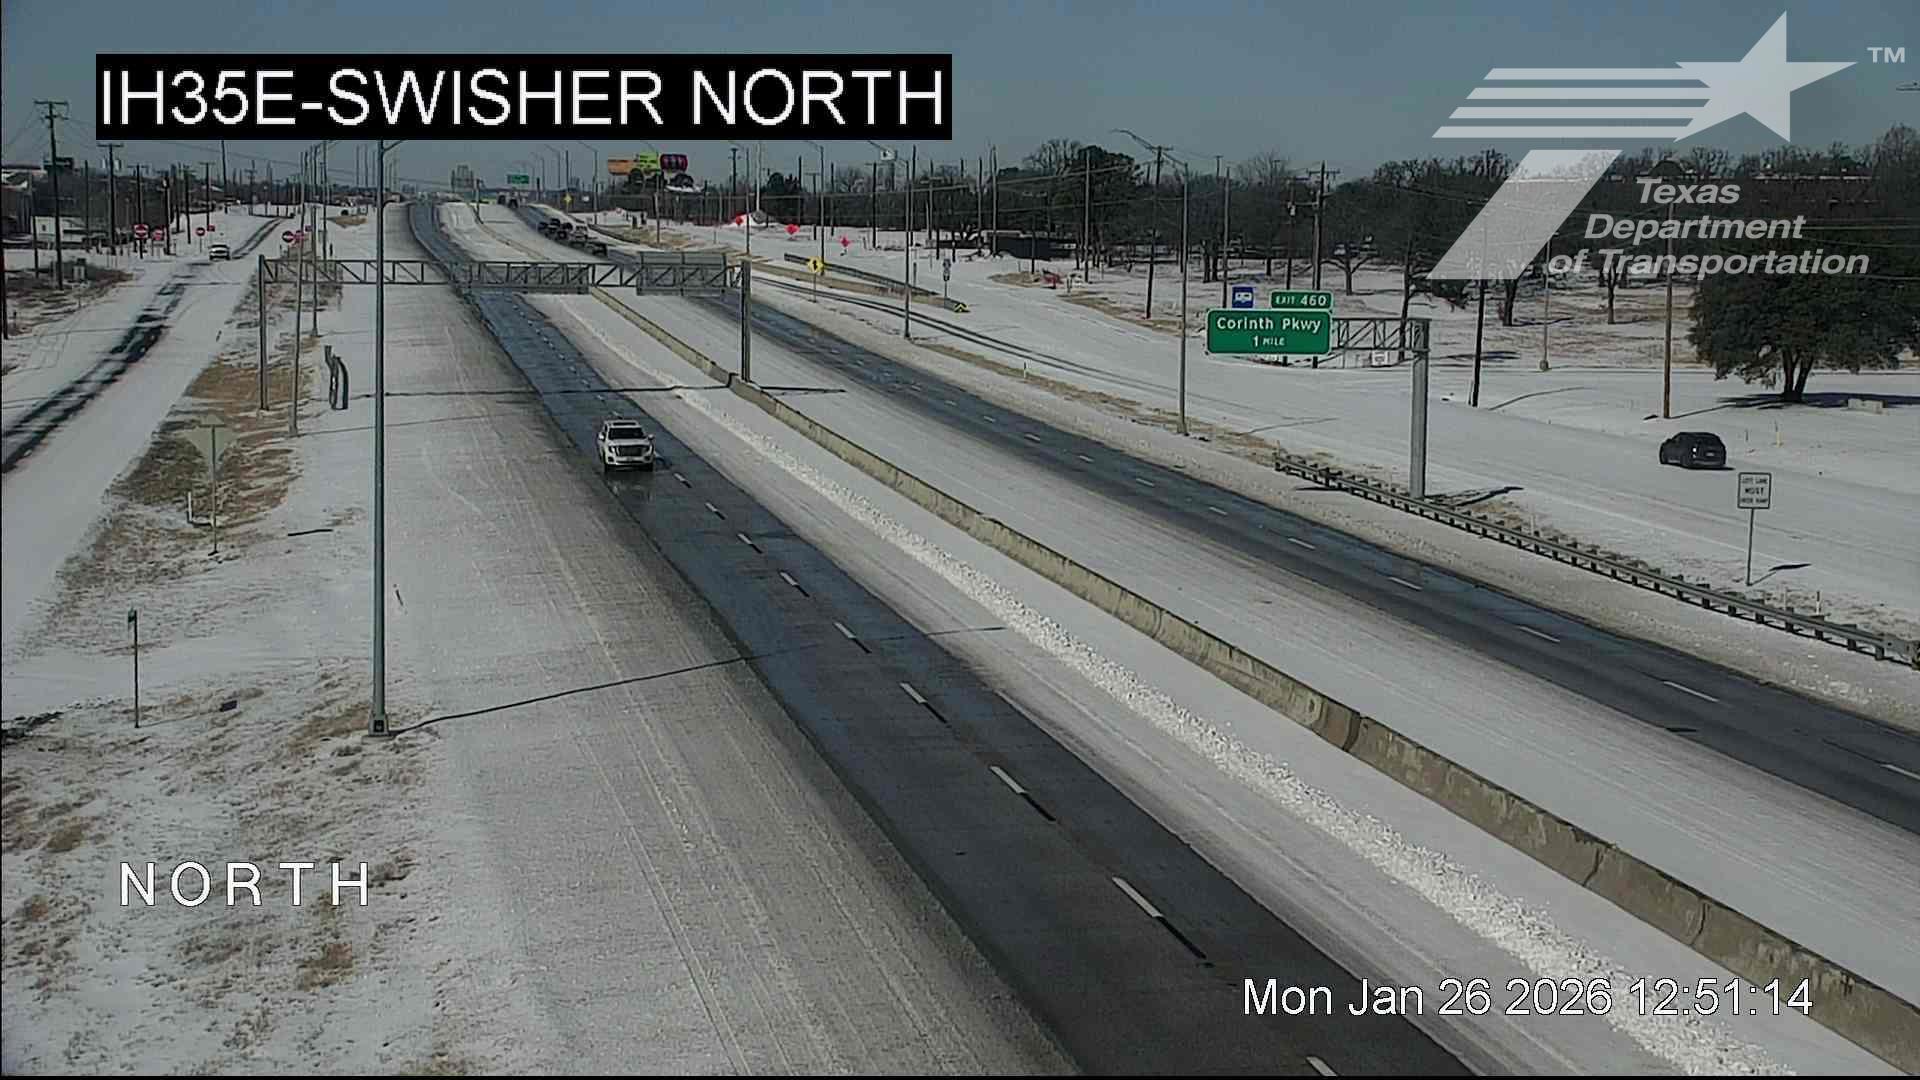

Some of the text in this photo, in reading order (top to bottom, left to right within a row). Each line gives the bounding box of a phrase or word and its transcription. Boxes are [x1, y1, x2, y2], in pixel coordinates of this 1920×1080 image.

[1300, 294, 1327, 306] 460
[1216, 316, 1321, 334] Corinth Pkwy
[1253, 335, 1285, 347] 1 MILE
